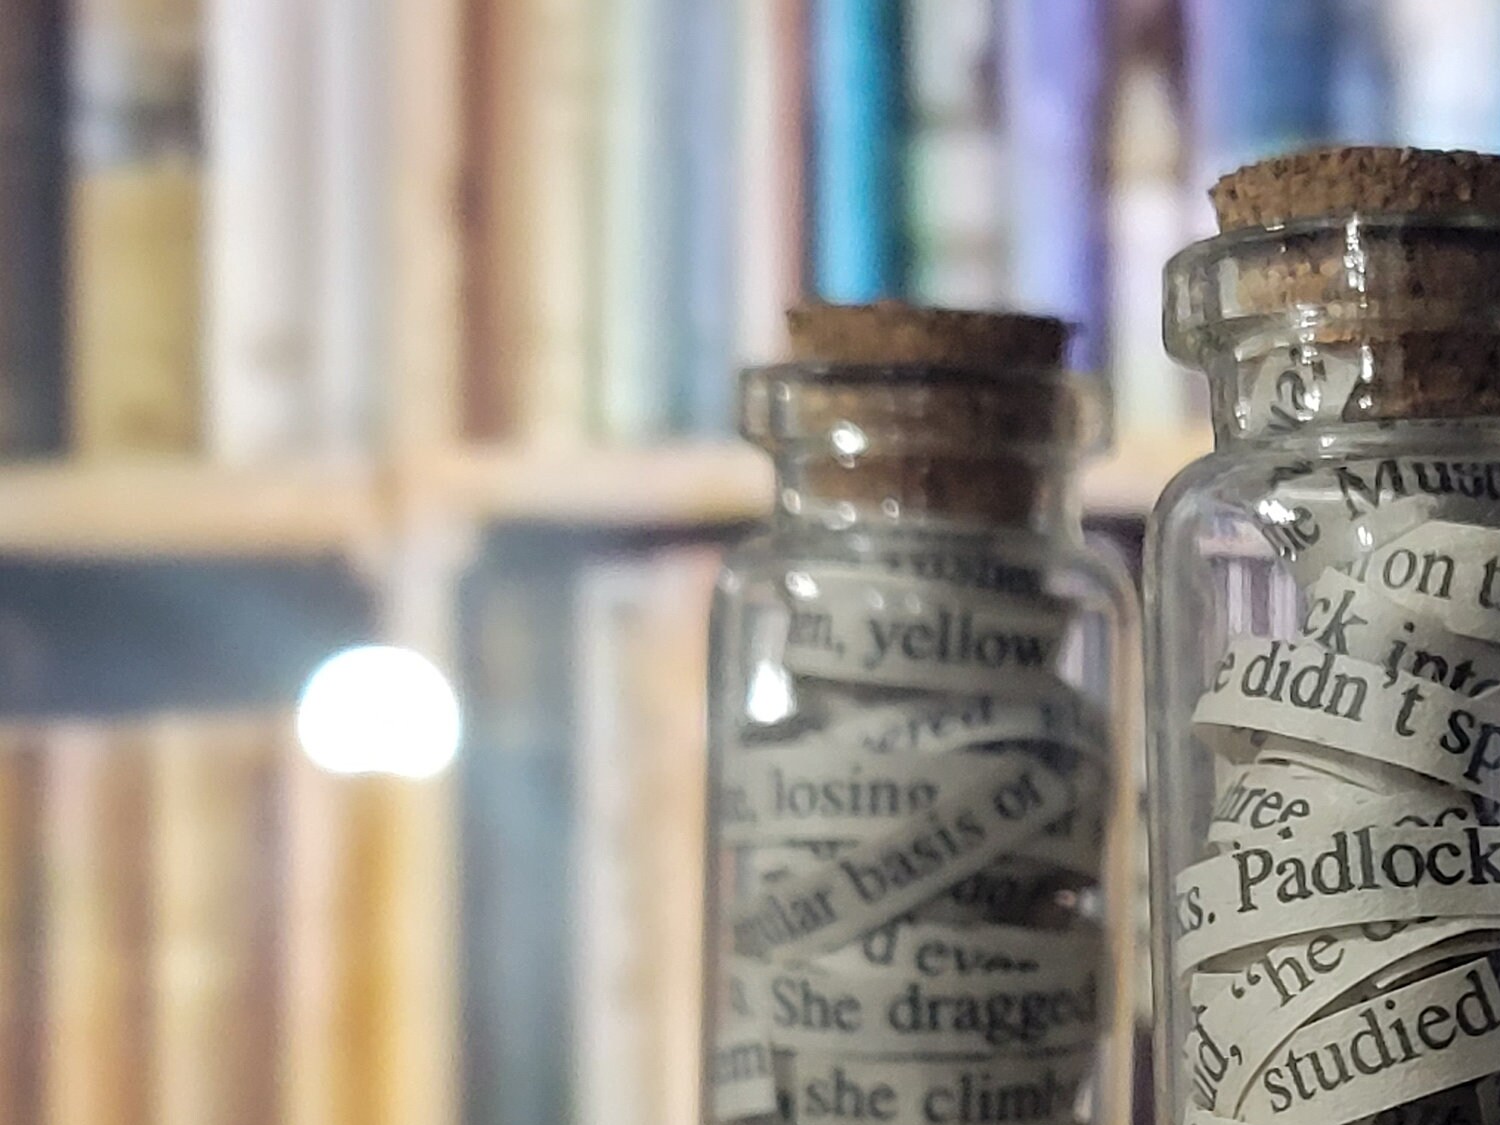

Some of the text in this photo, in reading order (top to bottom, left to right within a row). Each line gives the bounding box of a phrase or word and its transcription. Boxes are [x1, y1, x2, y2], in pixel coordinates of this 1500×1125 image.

[1382, 546, 1455, 600] on
[771, 975, 863, 1033] She
[804, 1066, 898, 1121] she
